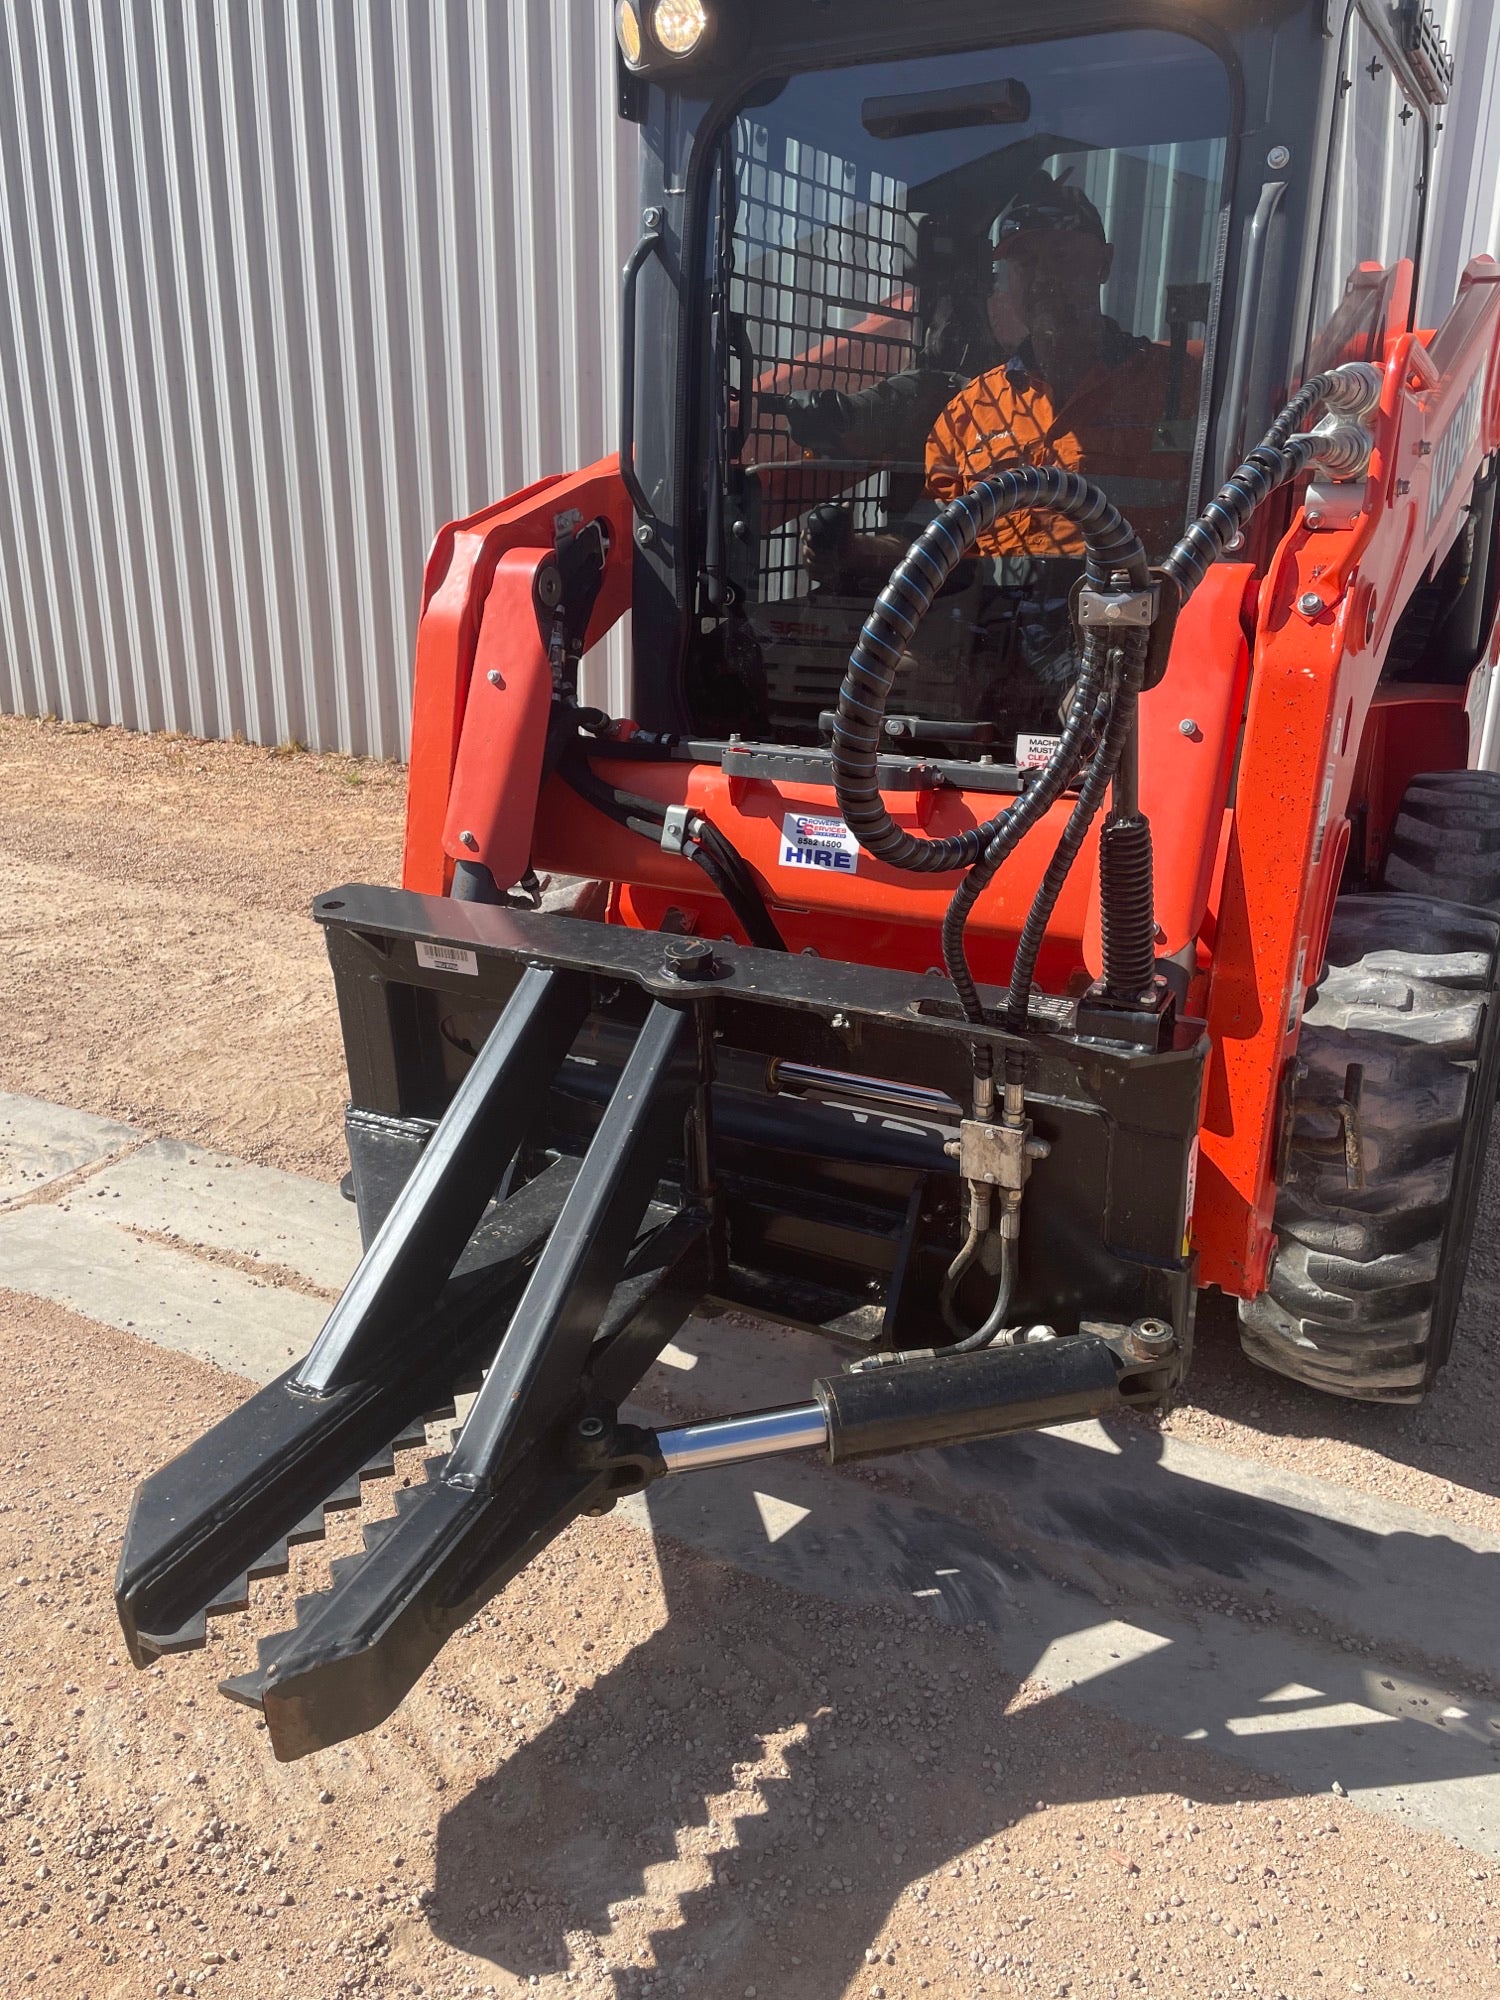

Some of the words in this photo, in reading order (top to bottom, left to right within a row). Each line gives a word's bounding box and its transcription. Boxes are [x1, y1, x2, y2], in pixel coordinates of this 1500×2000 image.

[1029, 738, 1061, 747] MACHIN
[796, 817, 841, 828] GROWERS
[803, 824, 847, 836] SERVICES
[797, 837, 818, 846] 8582
[821, 840, 842, 848] 1500
[785, 847, 851, 869] HIRE
